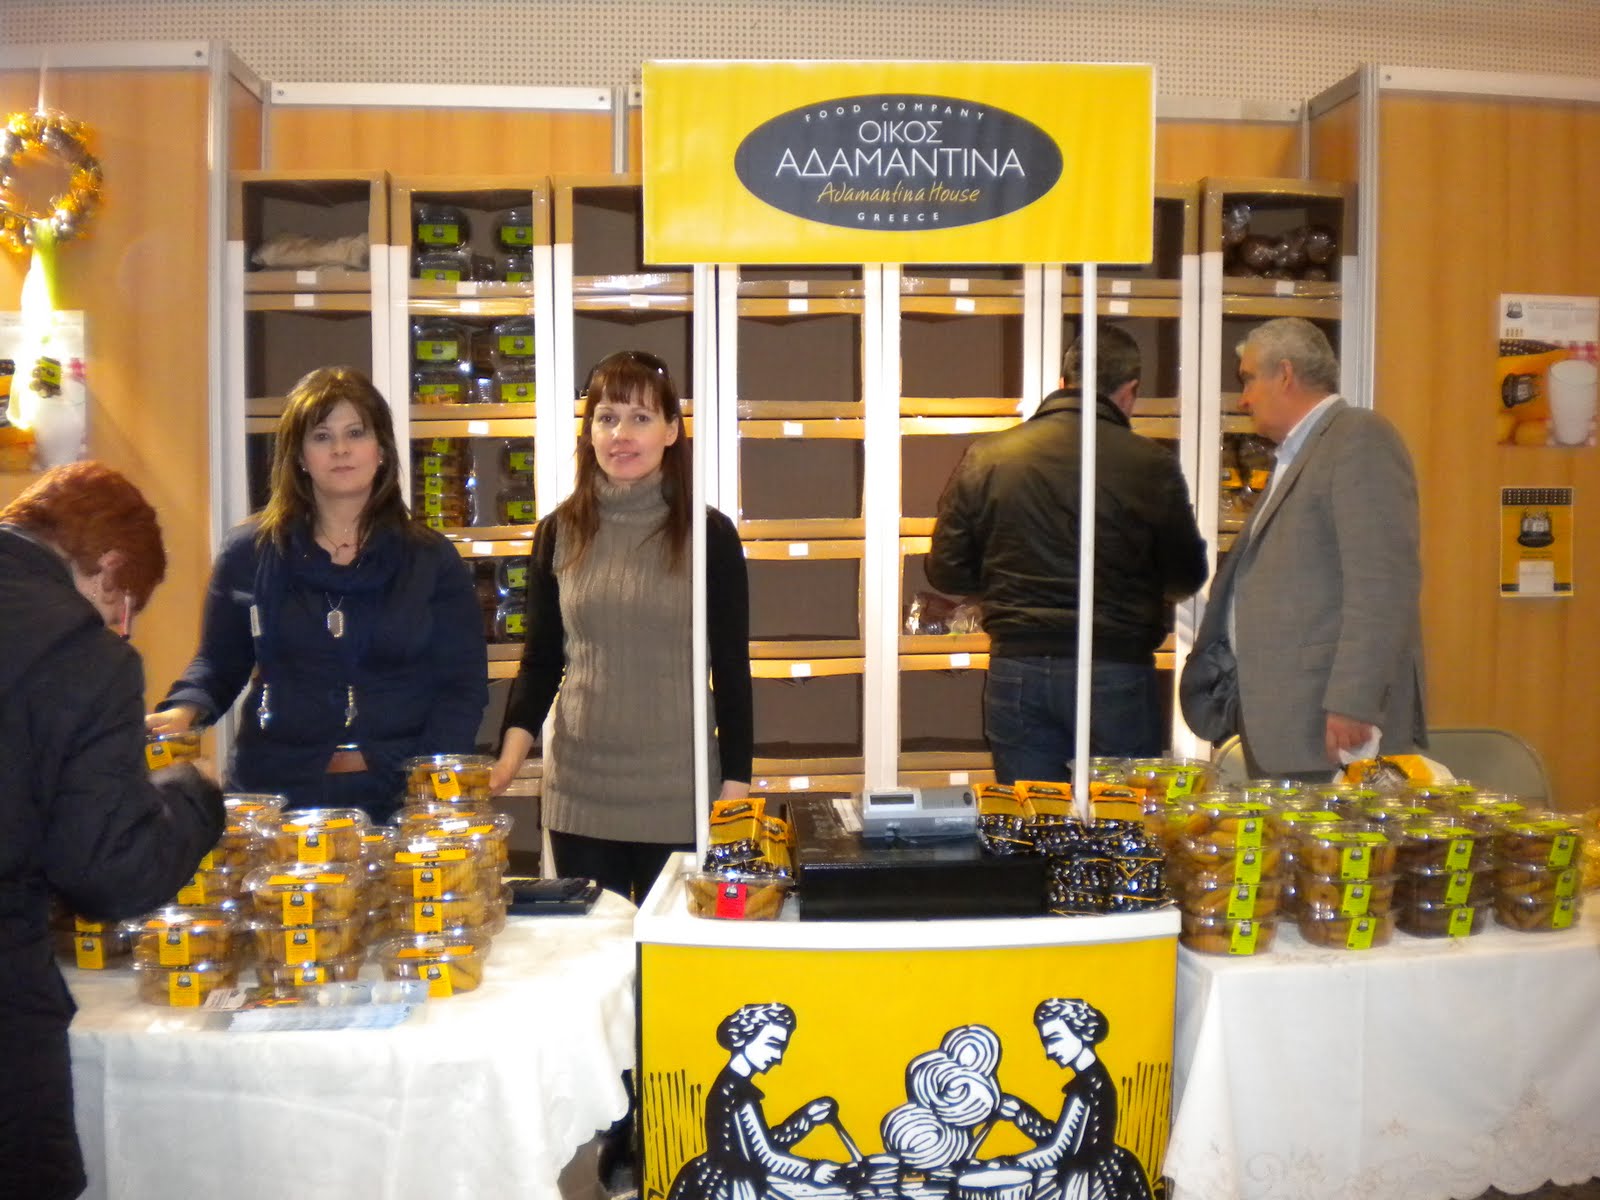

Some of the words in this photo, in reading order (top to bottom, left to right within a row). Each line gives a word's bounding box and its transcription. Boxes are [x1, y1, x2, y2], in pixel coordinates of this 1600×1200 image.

[804, 104, 862, 122] FOOD
[881, 102, 985, 121] COMPANY
[858, 120, 943, 143] ΟΙΚΟΣ
[775, 147, 1026, 177] ΑΔΑΜΑΝΤΙΝΑ
[816, 180, 925, 203] Adamantina
[928, 180, 981, 202] House
[857, 211, 940, 222] GREECE
